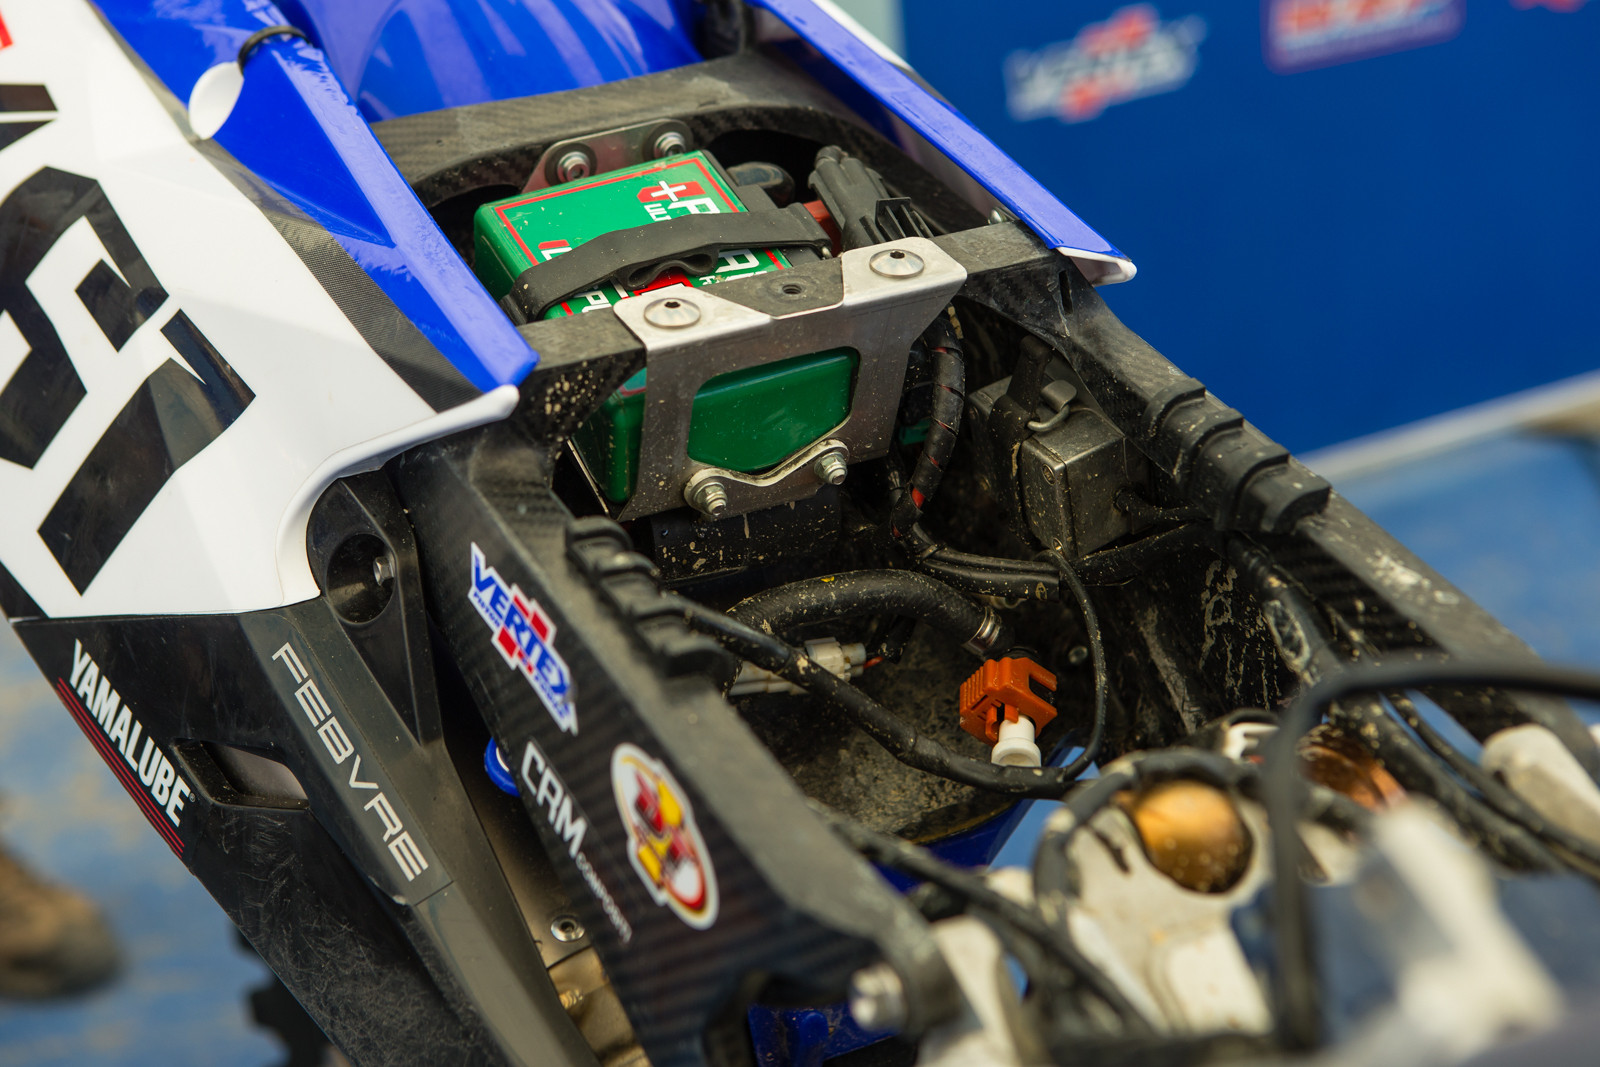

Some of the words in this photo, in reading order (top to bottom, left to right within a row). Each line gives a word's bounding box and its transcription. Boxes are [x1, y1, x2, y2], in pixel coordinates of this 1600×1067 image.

[0, 83, 256, 598] 61
[69, 638, 190, 828] YAMALUBE
[271, 642, 429, 882] FEBVRE
[520, 740, 588, 859] CRM
